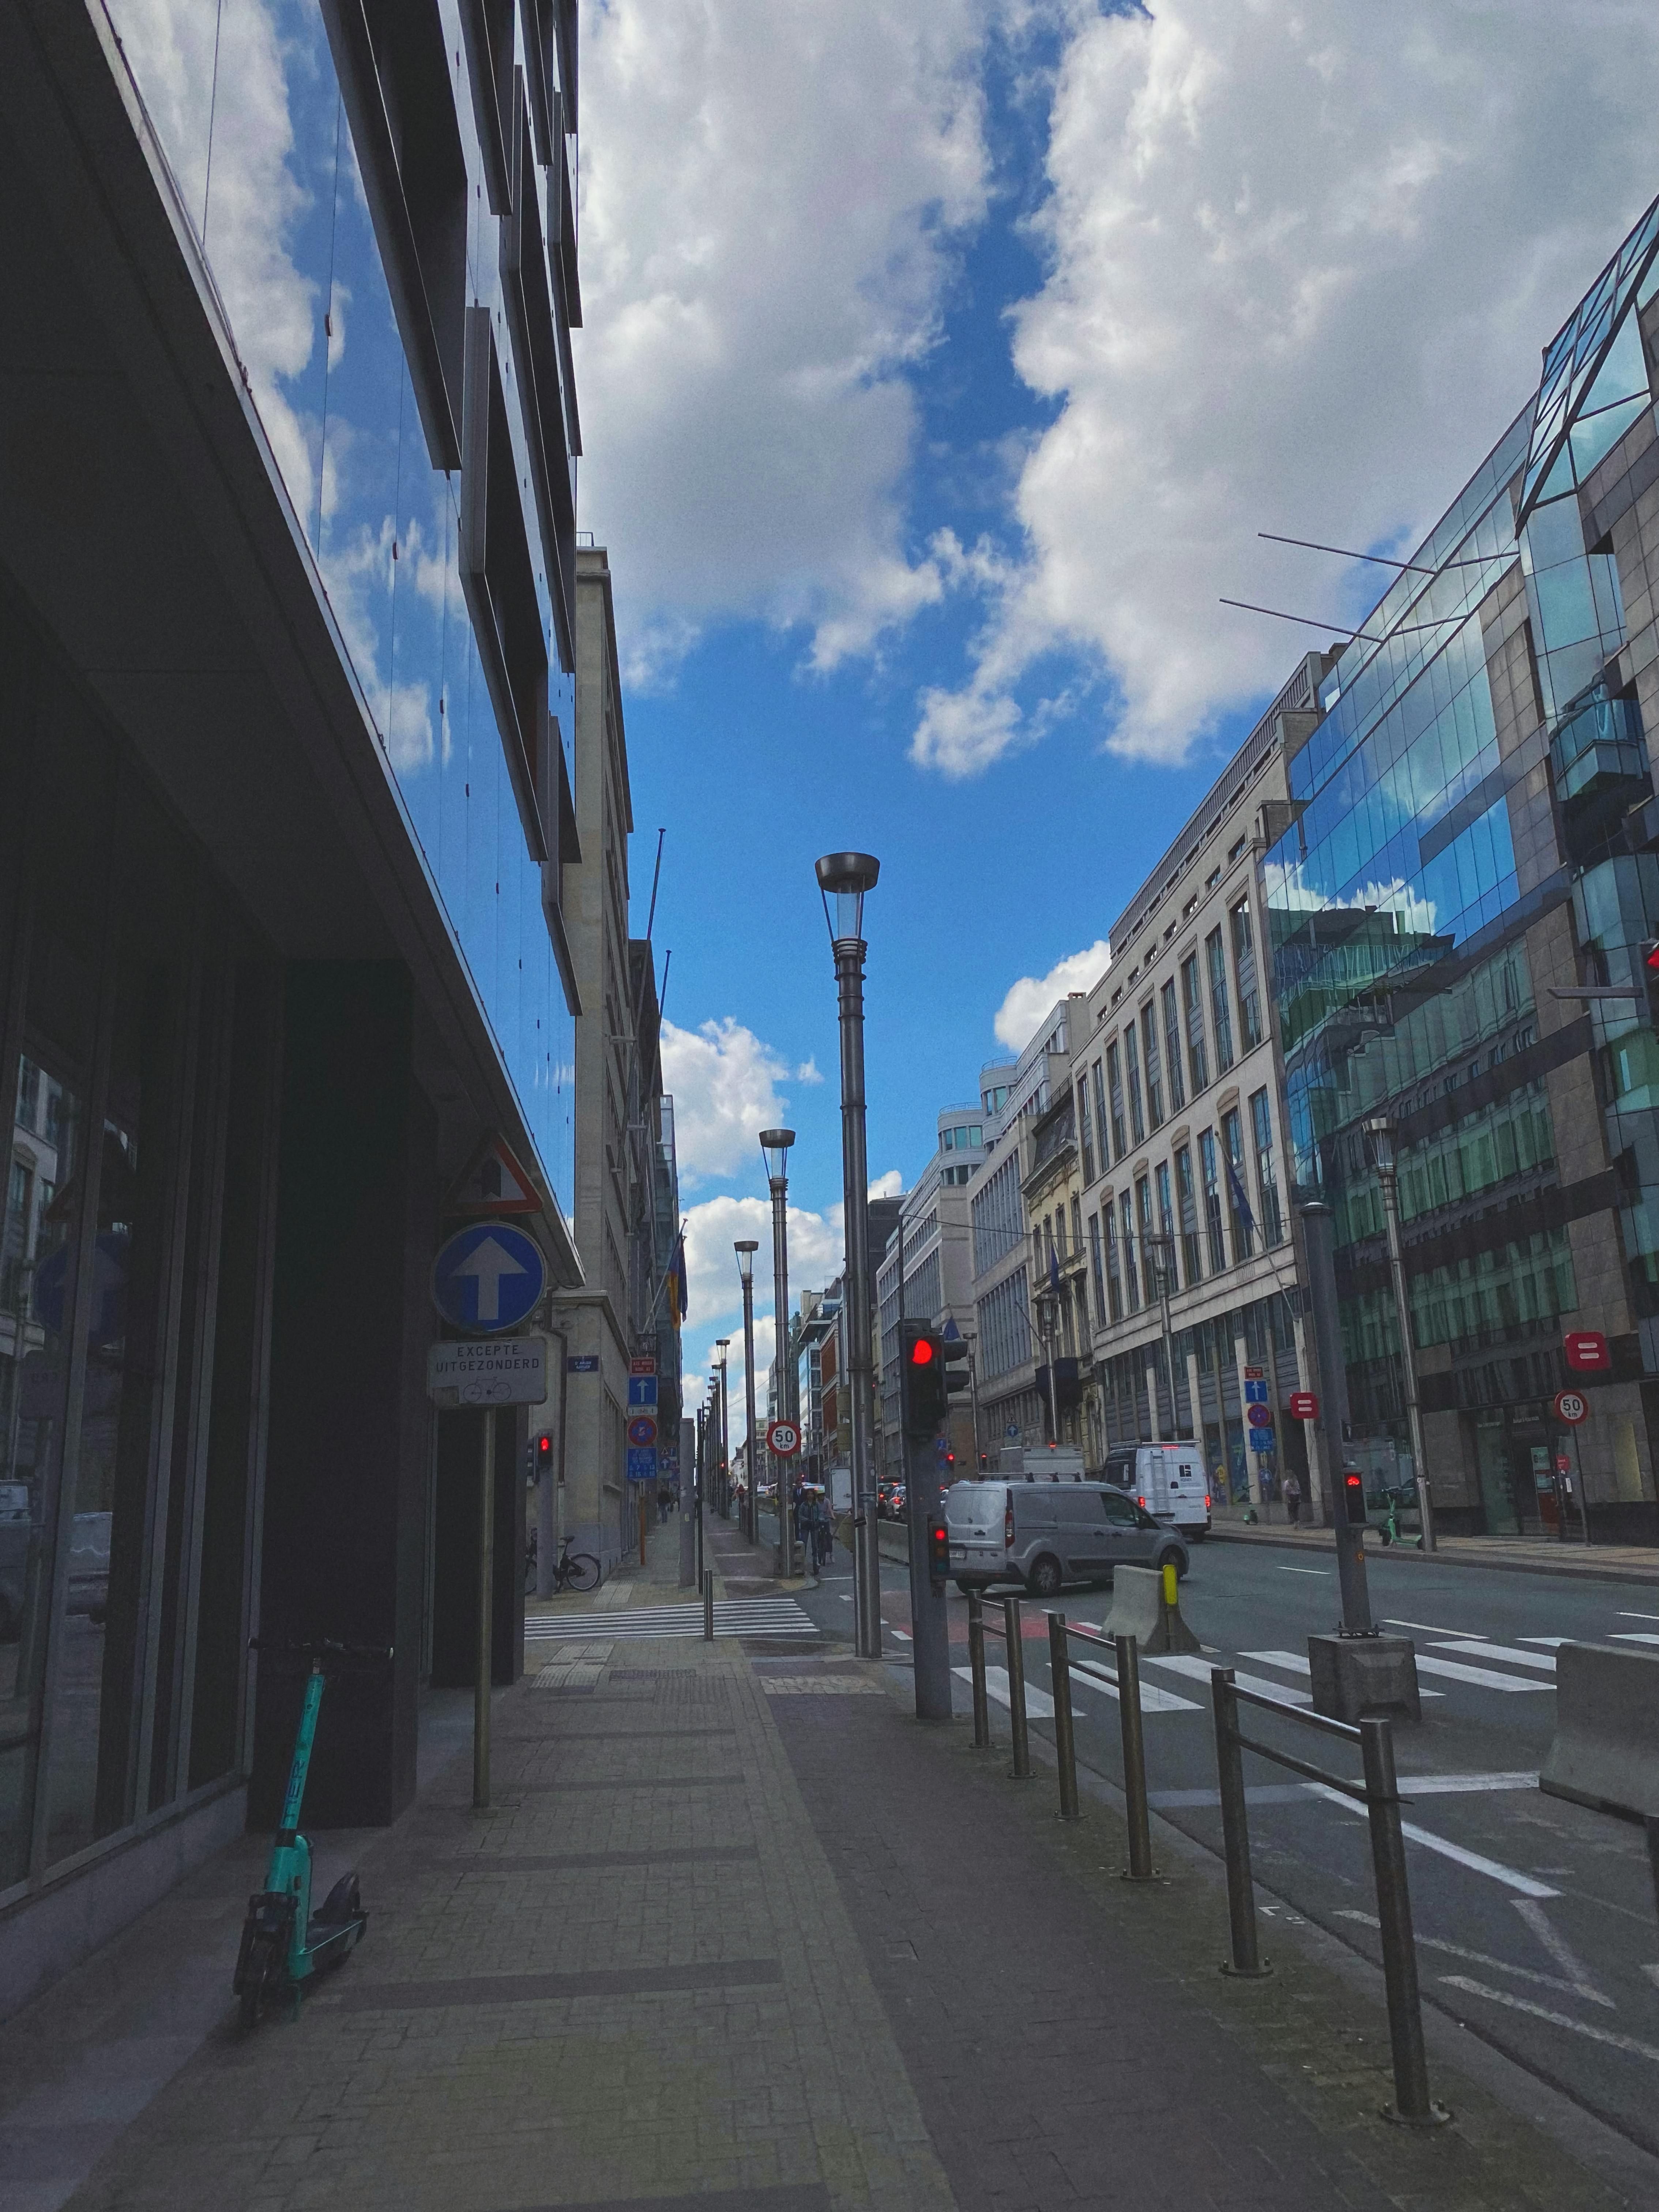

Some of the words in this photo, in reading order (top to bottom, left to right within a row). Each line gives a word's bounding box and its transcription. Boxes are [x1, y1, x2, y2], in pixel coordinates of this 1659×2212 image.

[458, 1345, 519, 1357] EXCEPTE
[436, 1358, 539, 1372] UITGEZONDERD
[1563, 1399, 1580, 1411] 50
[775, 1430, 793, 1442] 50
[283, 1761, 305, 1824] TIER
